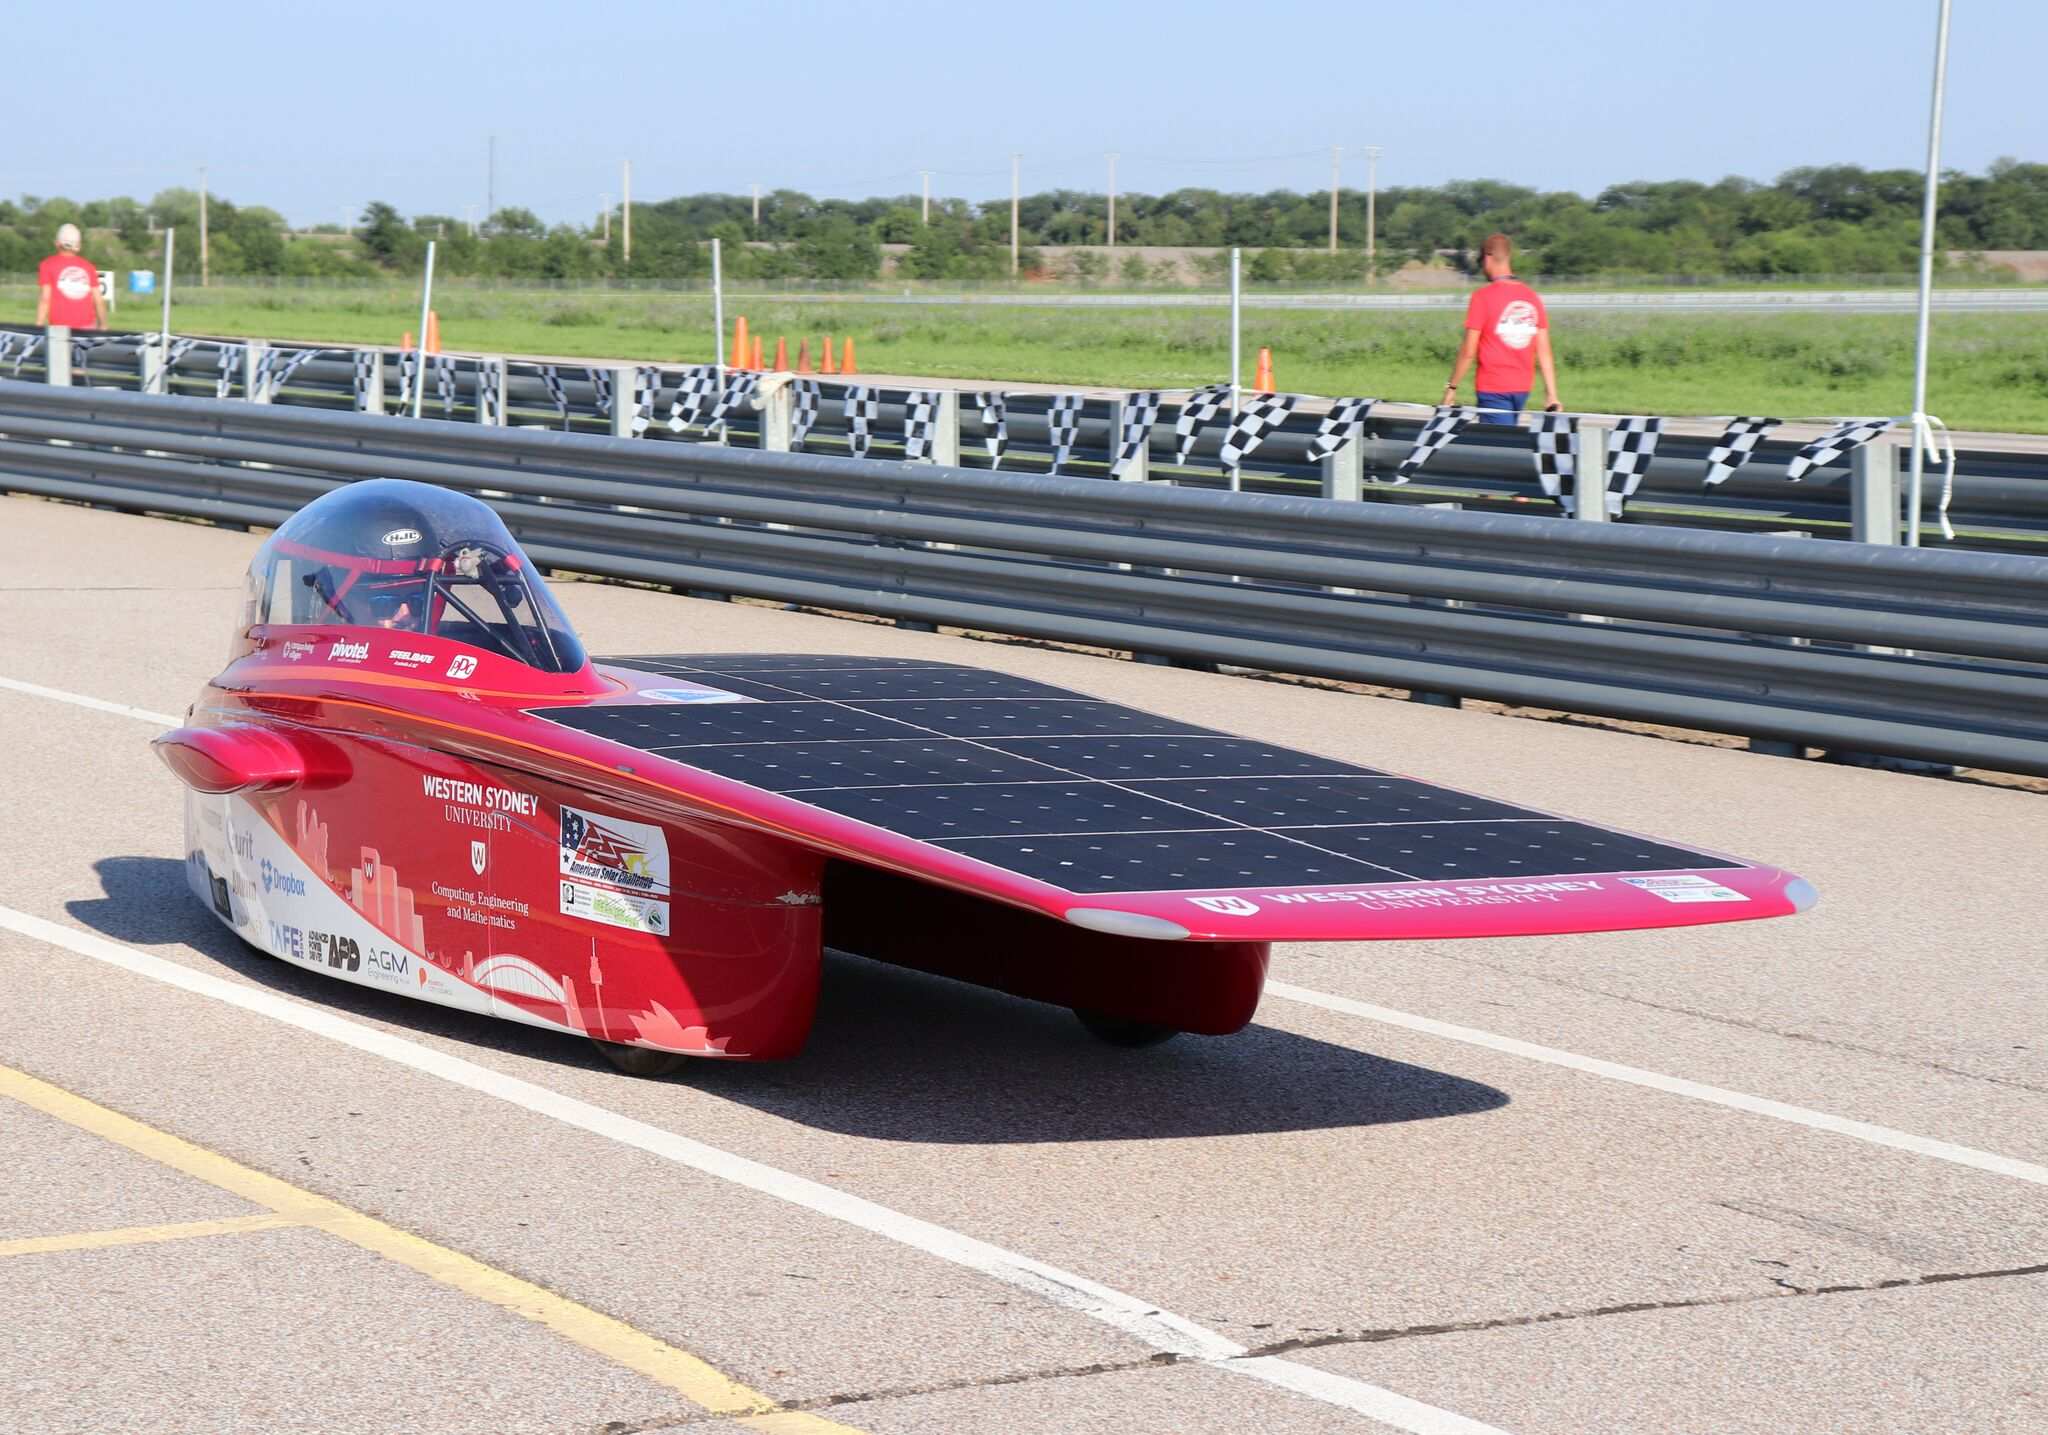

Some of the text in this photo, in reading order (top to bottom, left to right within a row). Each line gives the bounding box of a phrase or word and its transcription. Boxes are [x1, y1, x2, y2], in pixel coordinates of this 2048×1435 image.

[422, 775, 539, 816] WESTERN SYDNEY
[444, 805, 512, 832] UNIVERSITY
[274, 868, 305, 896] Dropbox
[569, 860, 600, 878] American
[478, 891, 529, 916] Engineering
[1261, 880, 1605, 904] WESTERN SYDNEY
[1360, 893, 1562, 911] UNIVERSITY
[447, 906, 516, 930] and Mathematics
[328, 934, 360, 972] APD
[368, 947, 409, 975] AGM
